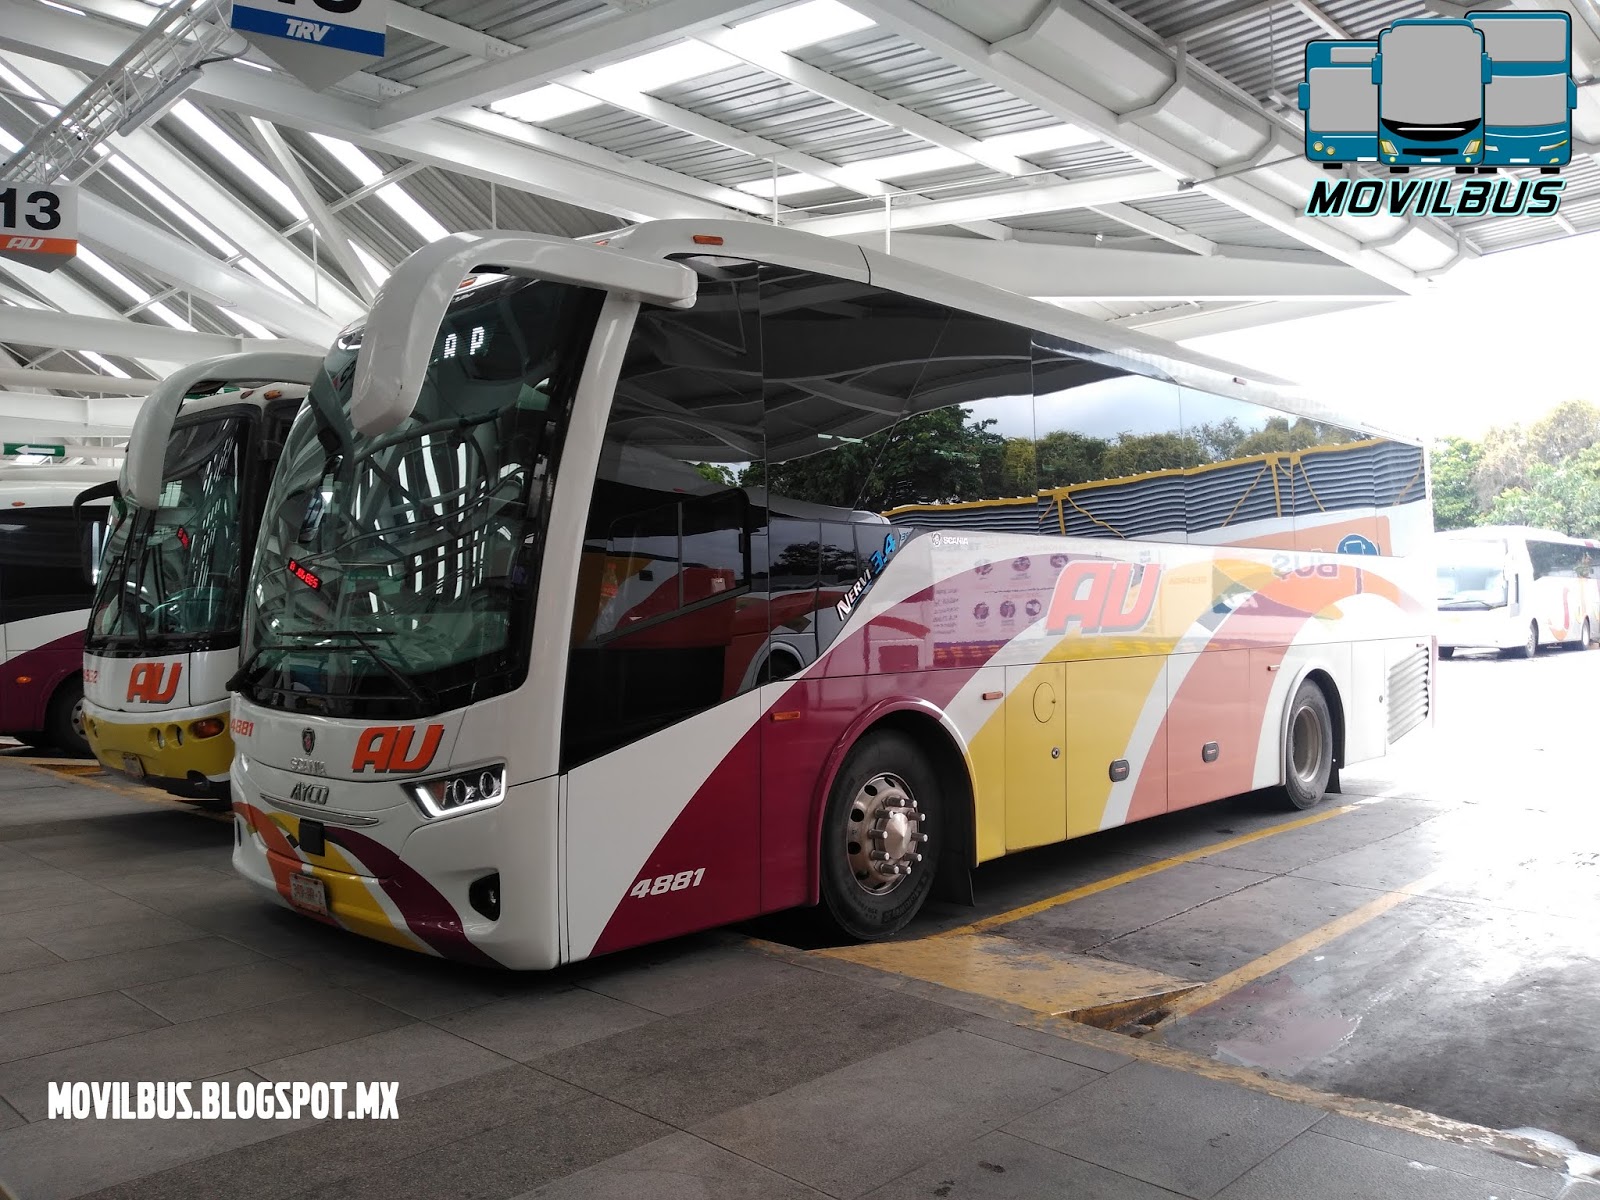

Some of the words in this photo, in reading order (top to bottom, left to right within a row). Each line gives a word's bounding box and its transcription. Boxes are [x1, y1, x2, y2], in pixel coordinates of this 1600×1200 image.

[286, 18, 330, 42] TRV
[0, 187, 61, 231] 13
[6, 237, 44, 251] AU
[942, 536, 969, 546] SCANIA
[1045, 559, 1164, 637] AU
[126, 662, 183, 705] AU
[230, 718, 255, 738] 4881
[351, 724, 445, 774] AU
[290, 756, 328, 776] SCANIA
[629, 867, 706, 899] 4881
